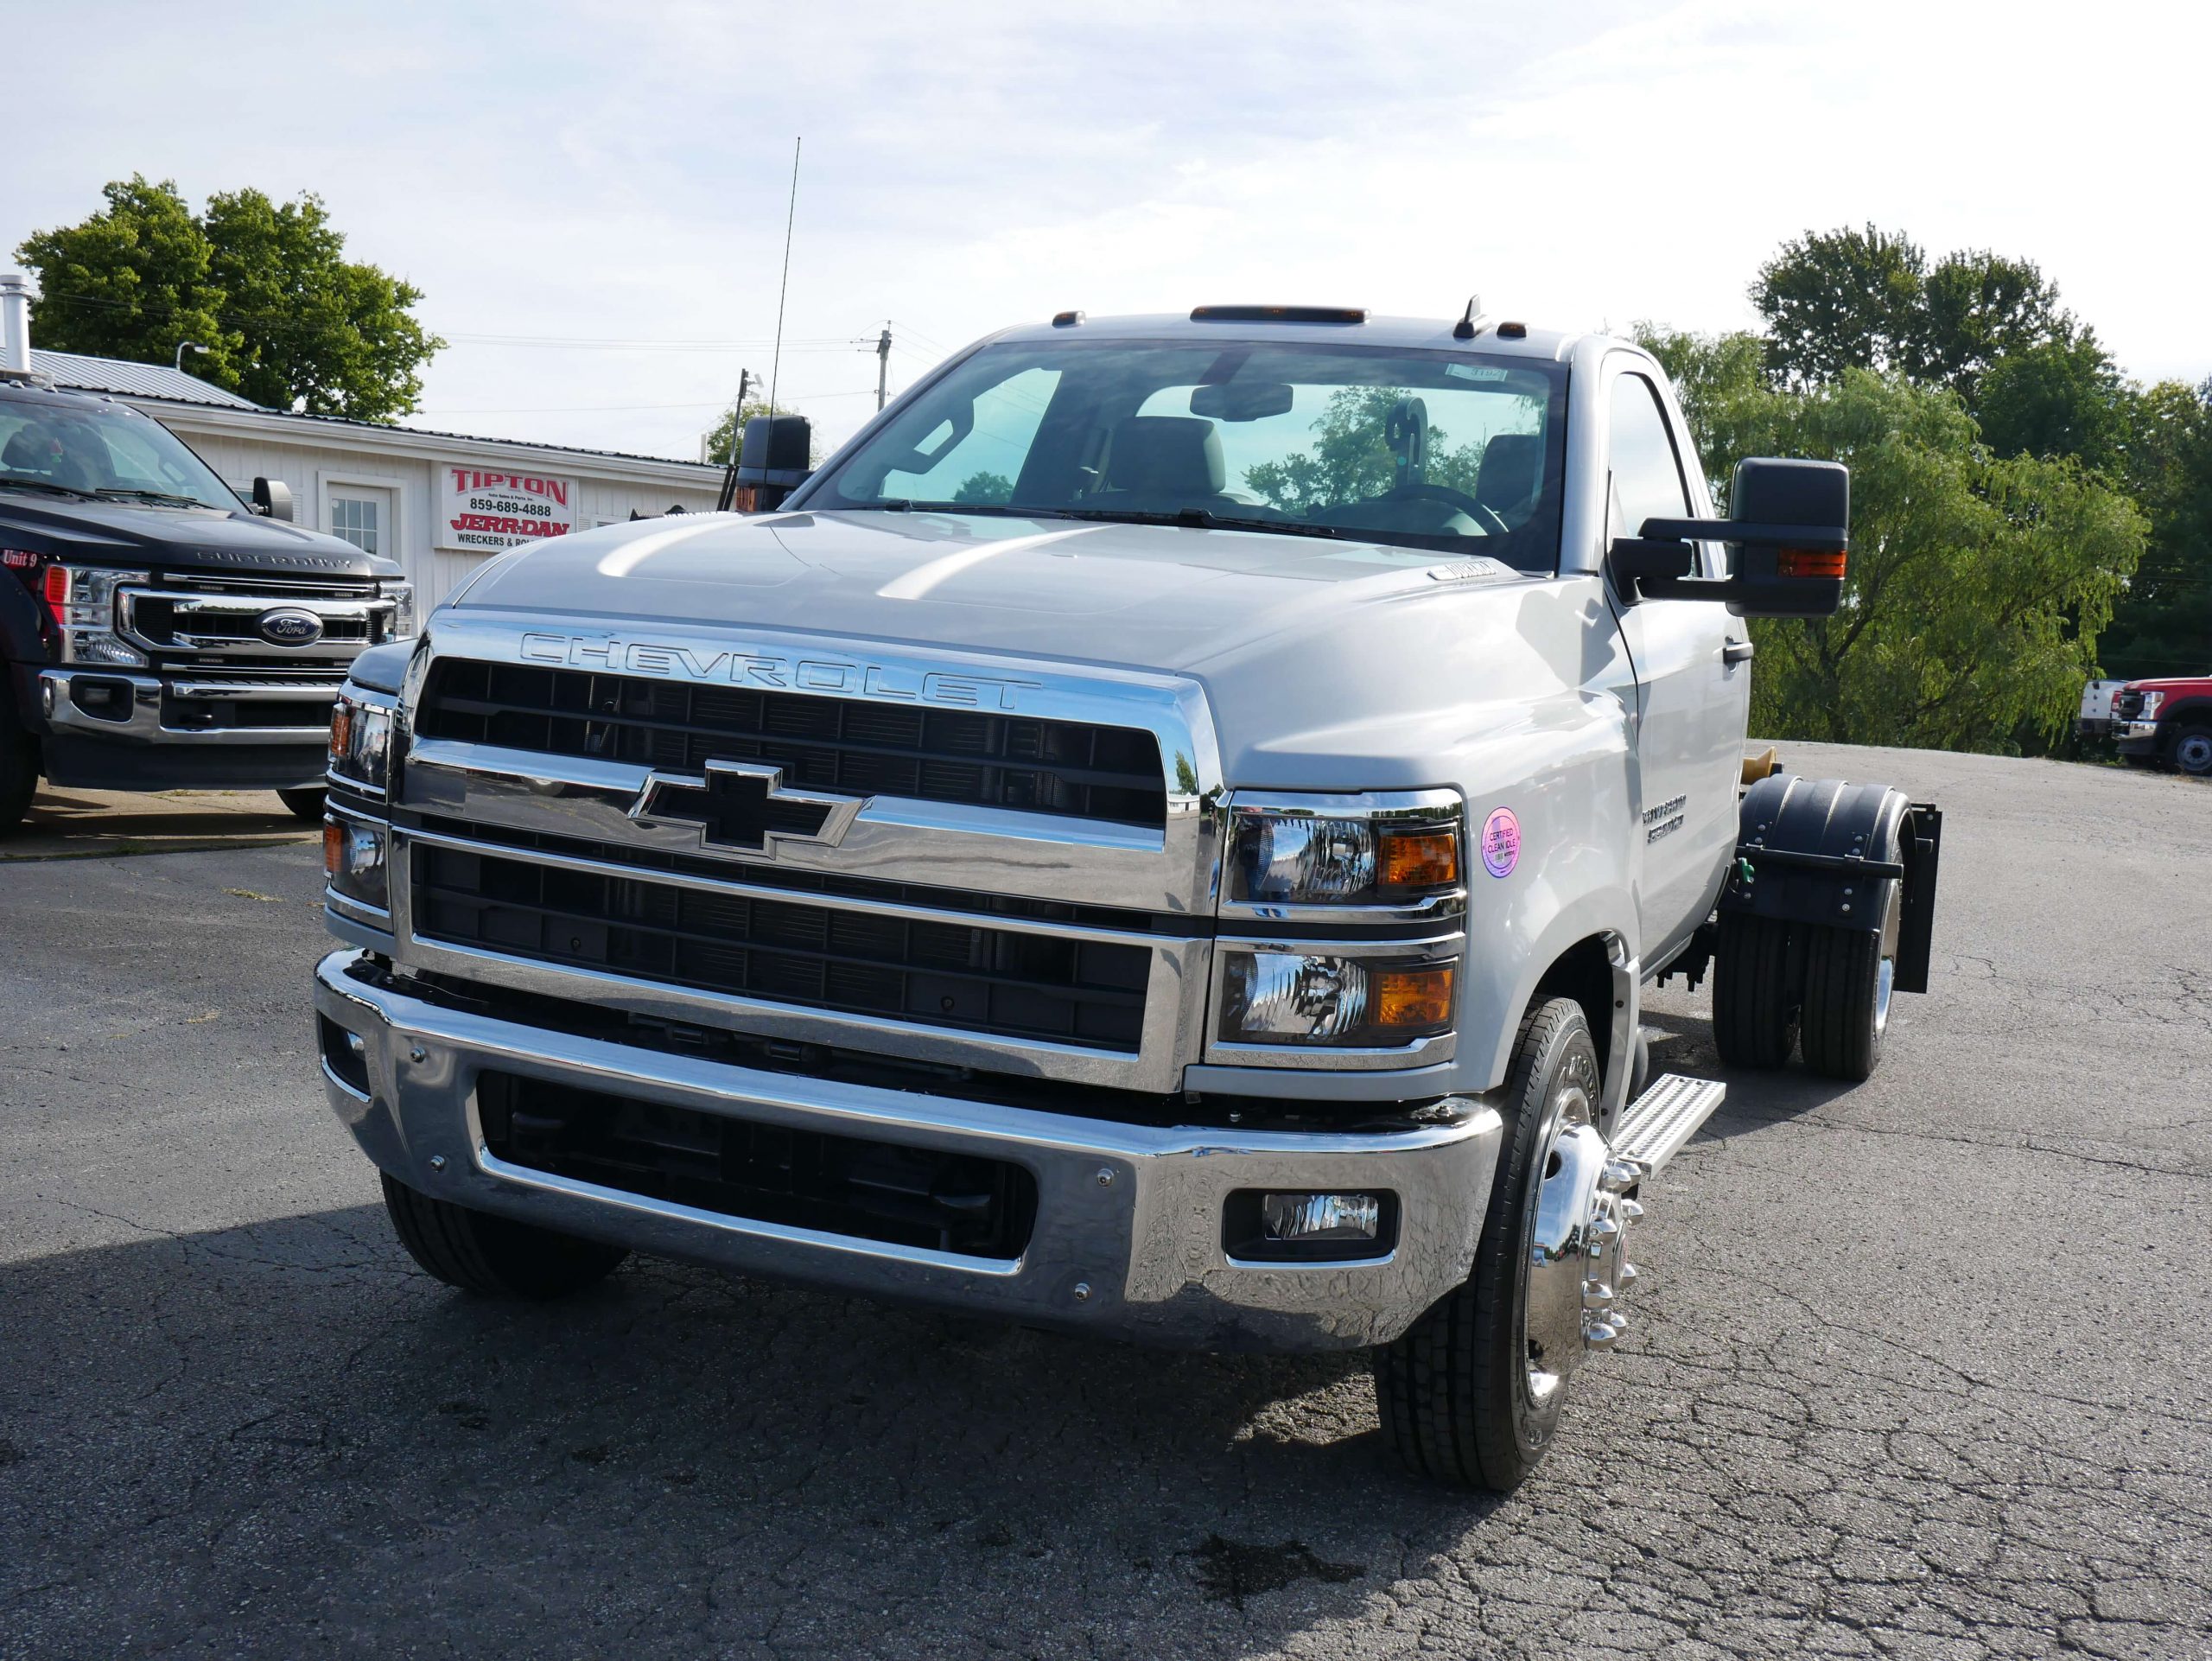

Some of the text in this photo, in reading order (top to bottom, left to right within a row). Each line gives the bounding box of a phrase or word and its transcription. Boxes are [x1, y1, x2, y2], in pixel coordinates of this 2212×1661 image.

[450, 468, 569, 508] TIPTON
[470, 498, 551, 517] 859-689-4888
[450, 513, 570, 538] JERR-DAN
[457, 533, 505, 546] WRECKERS
[506, 538, 513, 547] &
[3, 549, 37, 568] Unit 9
[276, 618, 308, 634] Ford
[519, 632, 1042, 710] CHEVROLET
[1490, 828, 1513, 841] CERTIFIED
[1487, 842, 1504, 854] CLEAN
[1505, 838, 1516, 849] IDLE
